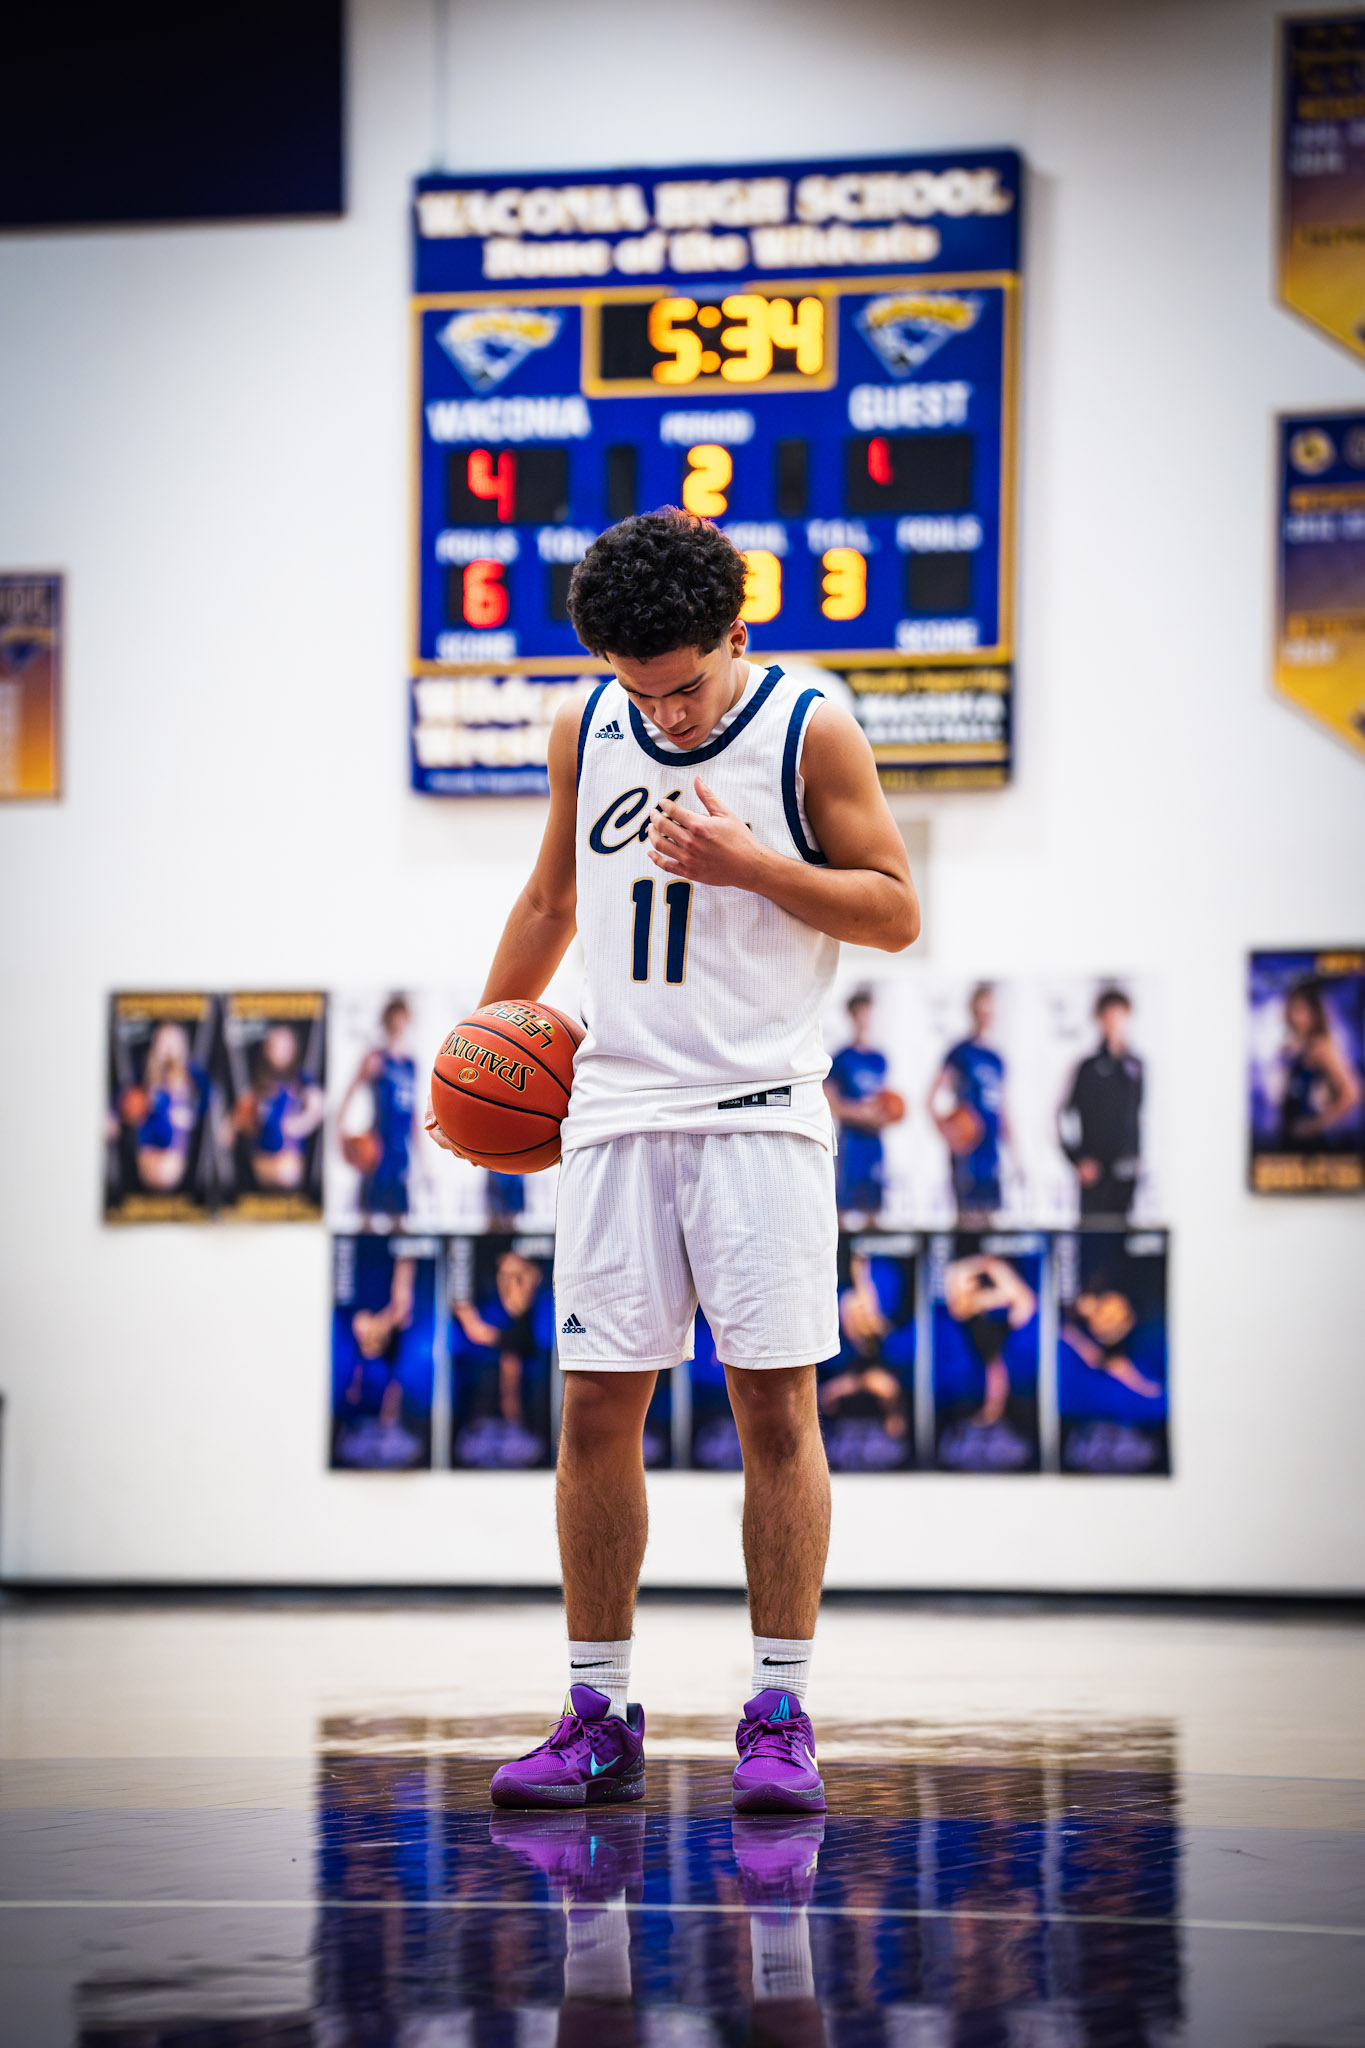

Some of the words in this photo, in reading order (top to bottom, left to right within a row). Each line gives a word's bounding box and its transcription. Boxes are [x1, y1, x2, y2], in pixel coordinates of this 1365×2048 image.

[795, 167, 1013, 223] SCHOOL
[648, 293, 825, 385] 5:34
[426, 396, 592, 443] WACONIA
[848, 381, 972, 431] GUEST
[467, 449, 516, 524] 4
[683, 444, 733, 518] 2
[462, 558, 509, 629] 6
[821, 548, 867, 621] 3
[594, 731, 624, 740] adidas
[630, 876, 694, 986] 11
[440, 1032, 536, 1092] SPALDING
